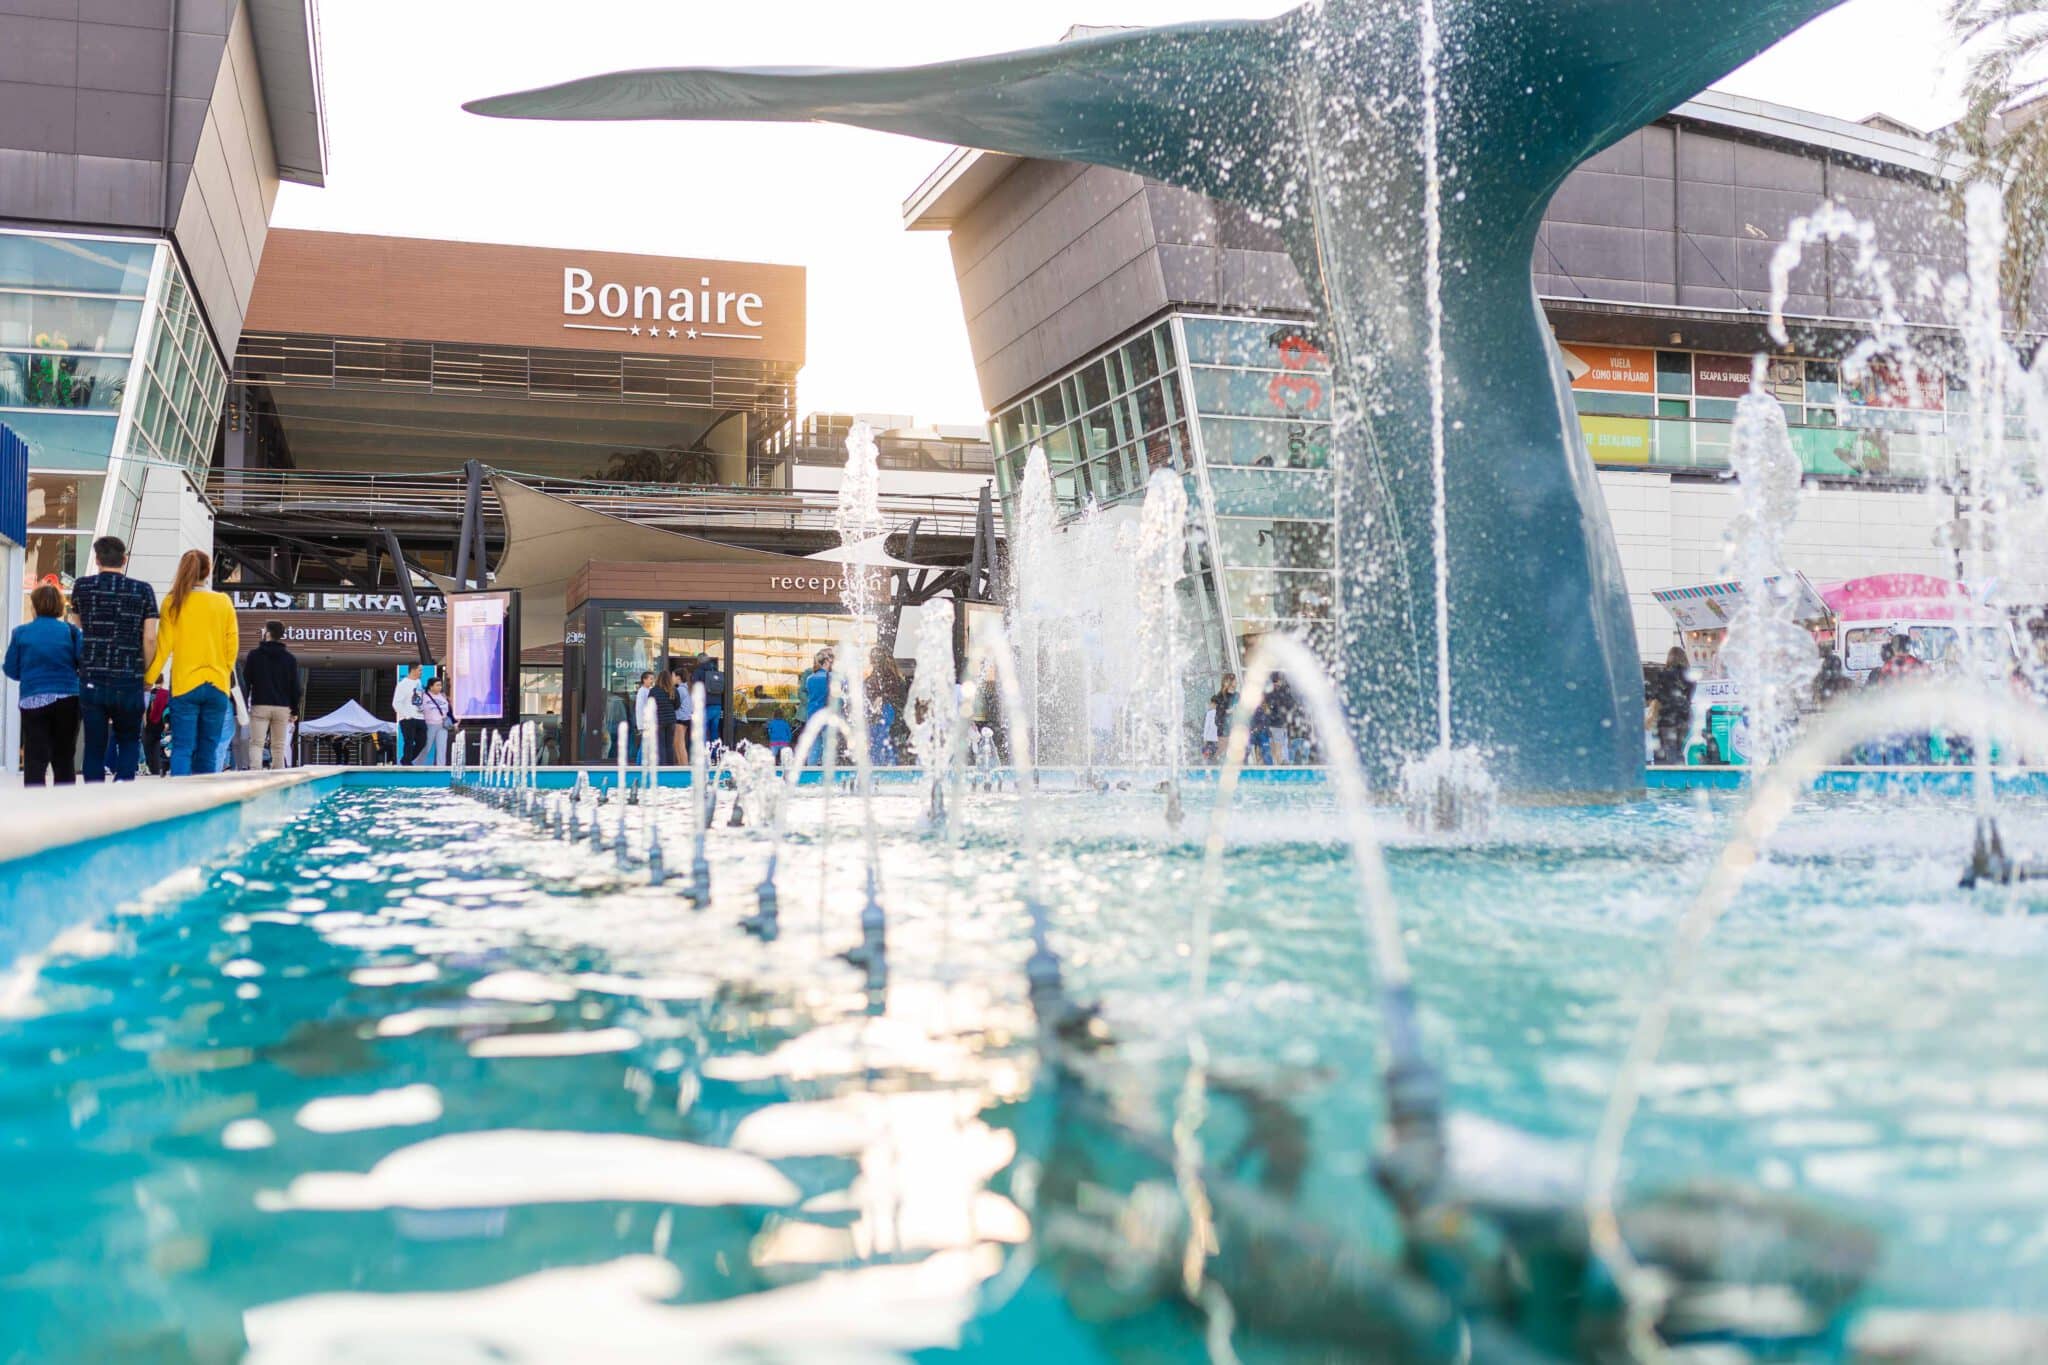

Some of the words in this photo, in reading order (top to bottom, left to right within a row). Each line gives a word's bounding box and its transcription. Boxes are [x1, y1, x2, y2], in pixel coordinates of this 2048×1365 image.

[563, 267, 764, 327] Bonaire
[1609, 357, 1631, 369] VUELA
[1591, 369, 1611, 380] COMO
[1612, 370, 1622, 381] UN
[1623, 369, 1649, 383] PÁJARO
[1699, 371, 1721, 381] ESCAPA
[1722, 372, 1728, 382] SI
[1729, 373, 1751, 383] PUEDES
[234, 591, 292, 609] LAS
[260, 626, 372, 642] rstaurantes
[377, 631, 389, 645] y
[394, 627, 427, 643] cin
